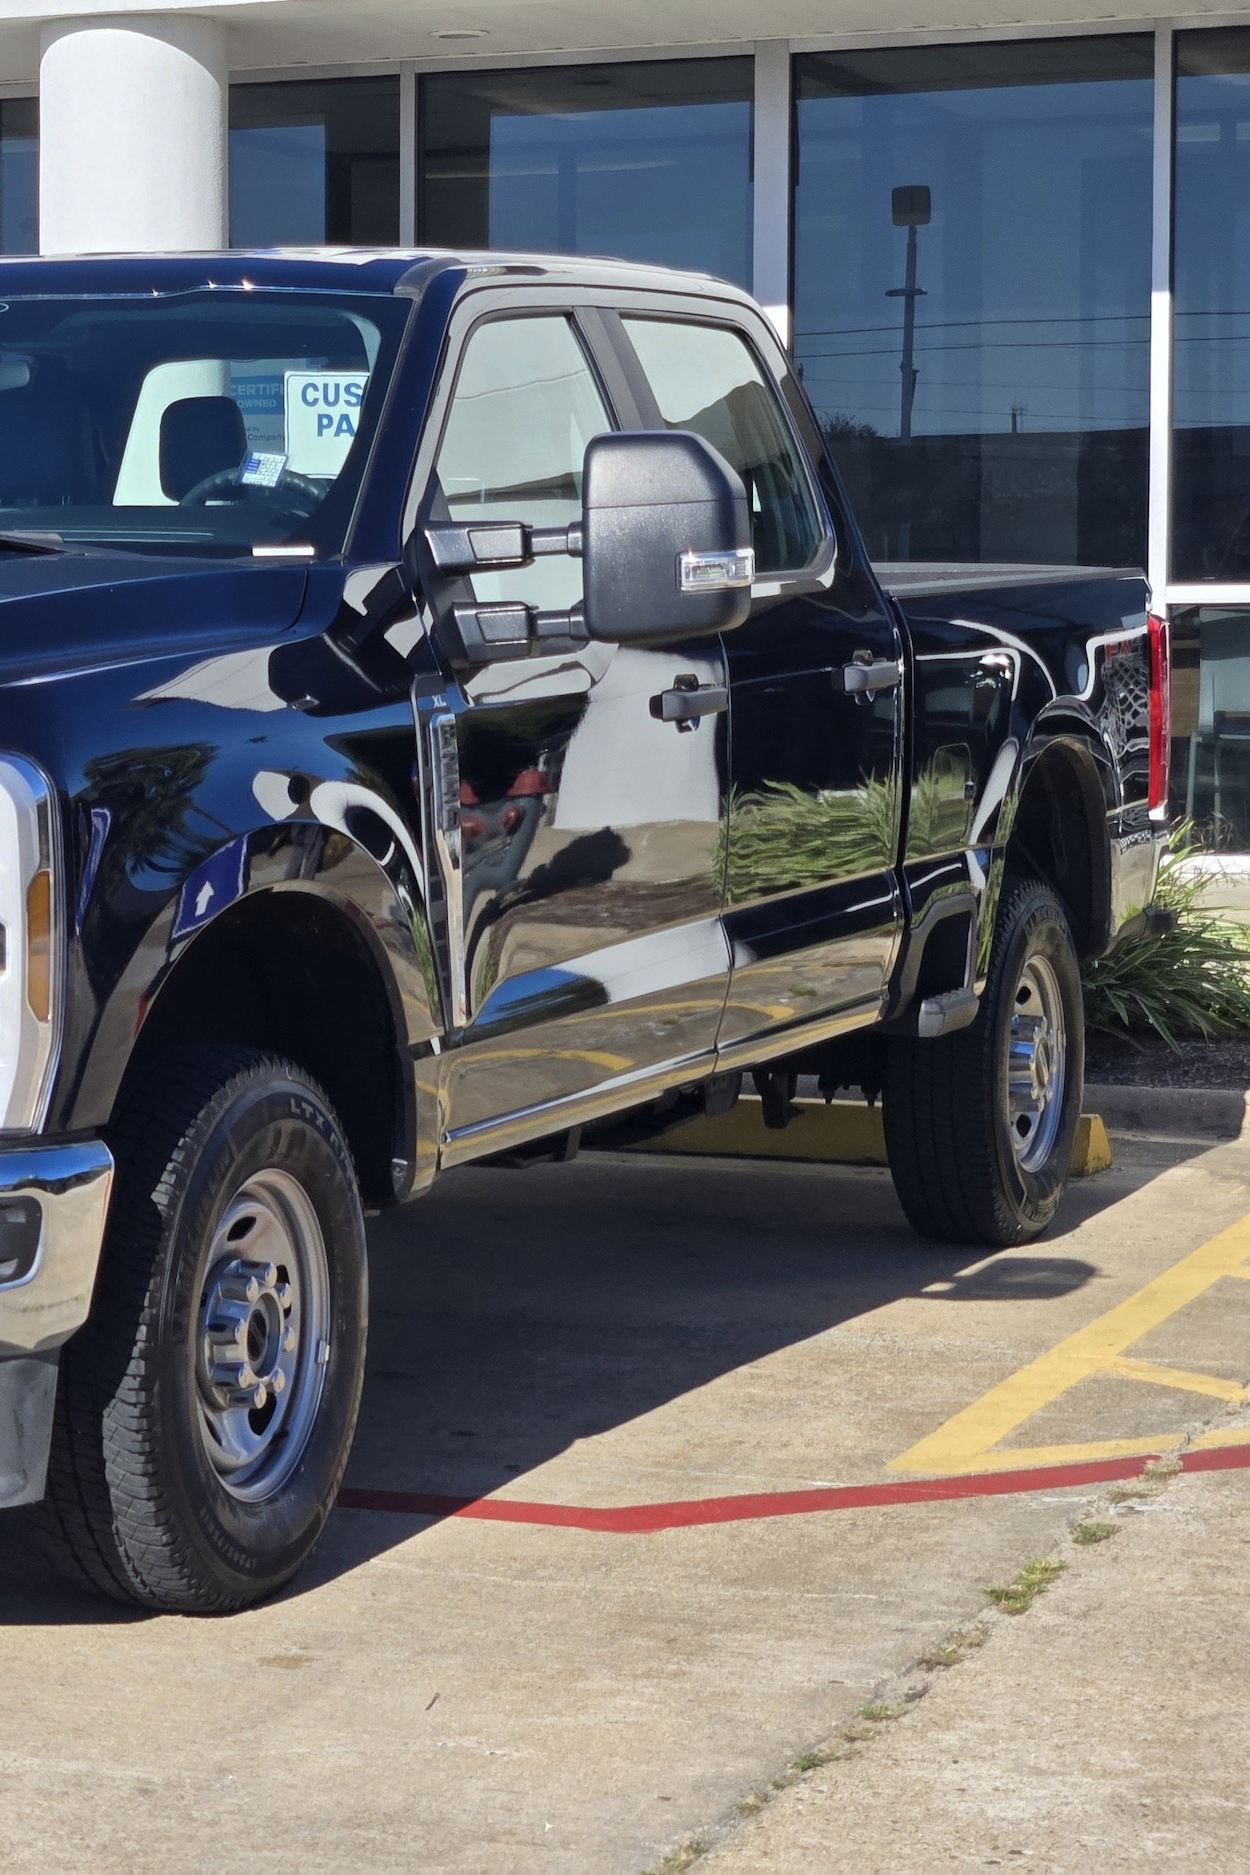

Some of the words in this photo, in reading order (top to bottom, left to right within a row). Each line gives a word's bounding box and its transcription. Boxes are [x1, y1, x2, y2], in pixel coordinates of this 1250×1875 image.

[230, 383, 283, 396] CERTIFI
[301, 382, 363, 408] CUS
[238, 399, 277, 409] OWNED
[317, 413, 356, 438] PA
[431, 694, 447, 708] XL
